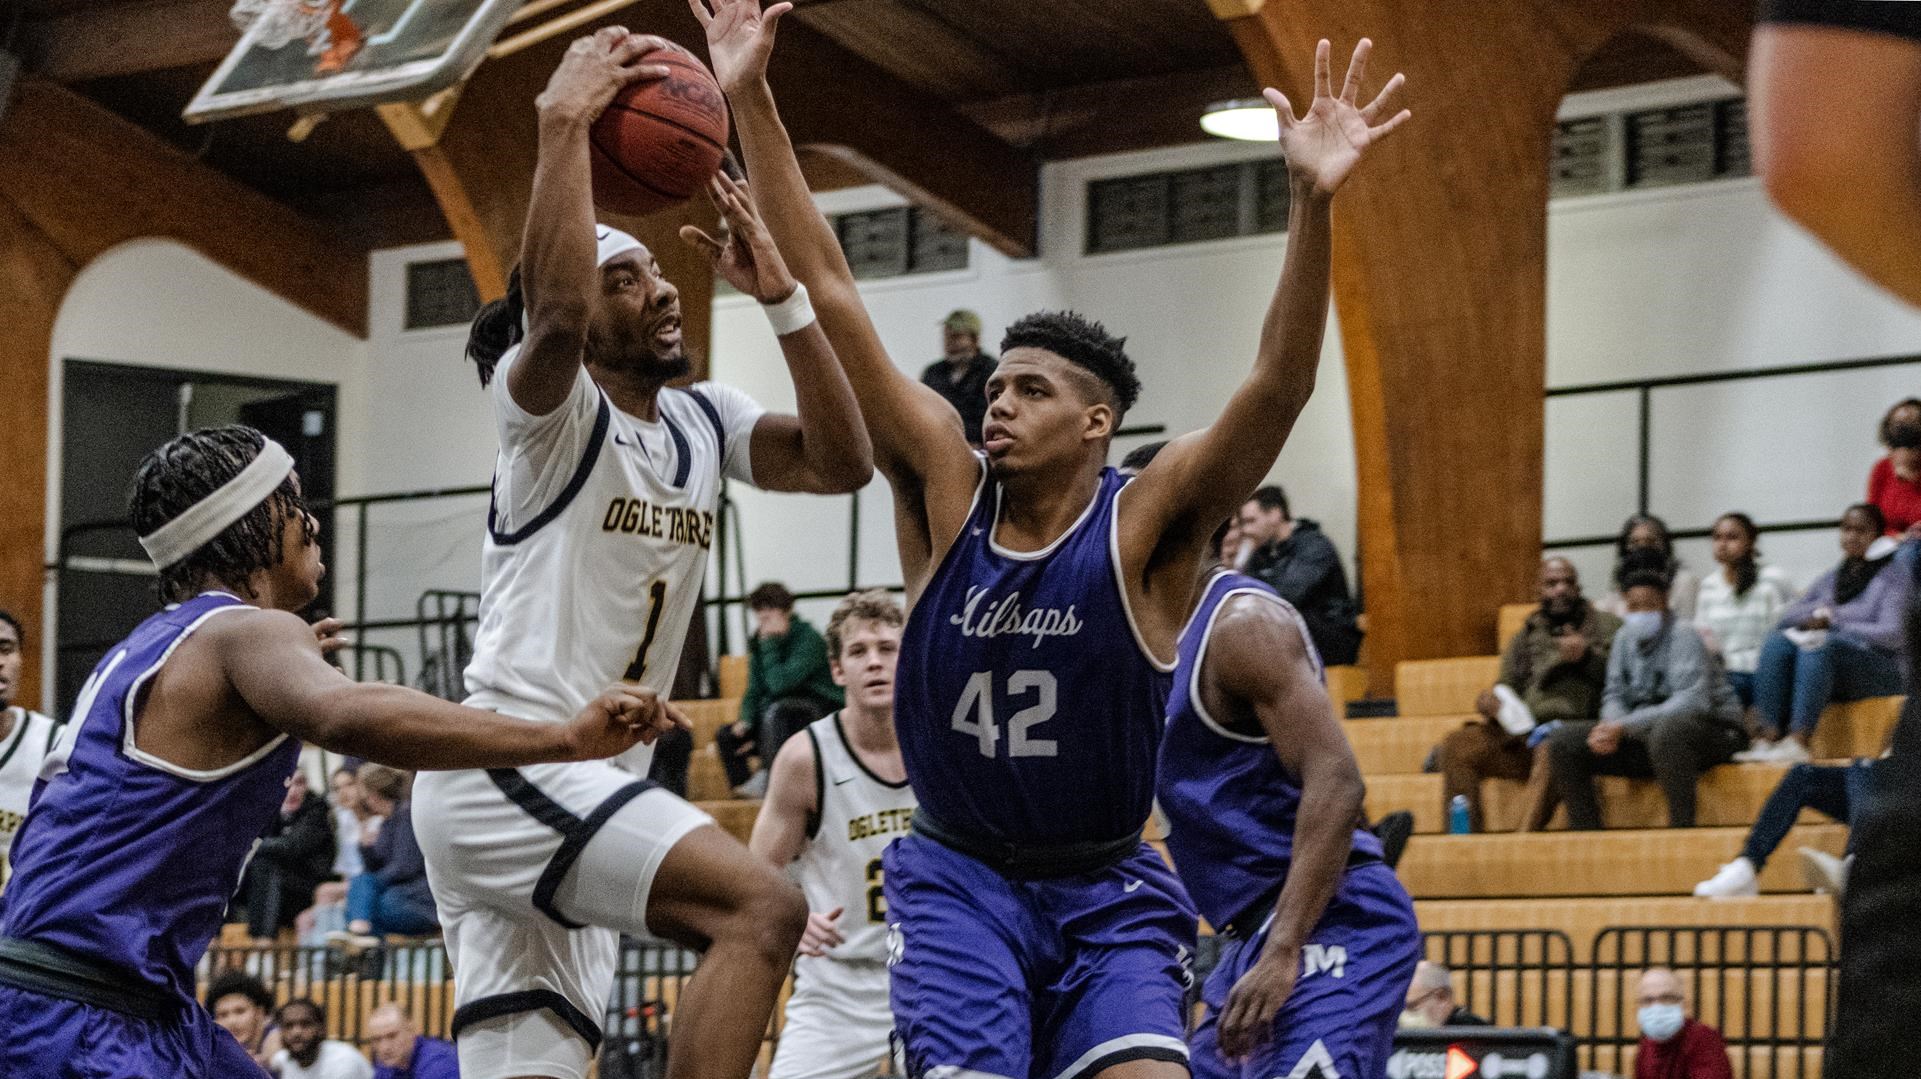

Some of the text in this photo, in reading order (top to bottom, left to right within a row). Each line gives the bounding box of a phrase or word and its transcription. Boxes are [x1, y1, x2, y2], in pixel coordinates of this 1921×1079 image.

[622, 579, 667, 684] 1
[951, 669, 1058, 759] 42
[1301, 943, 1348, 979] M
